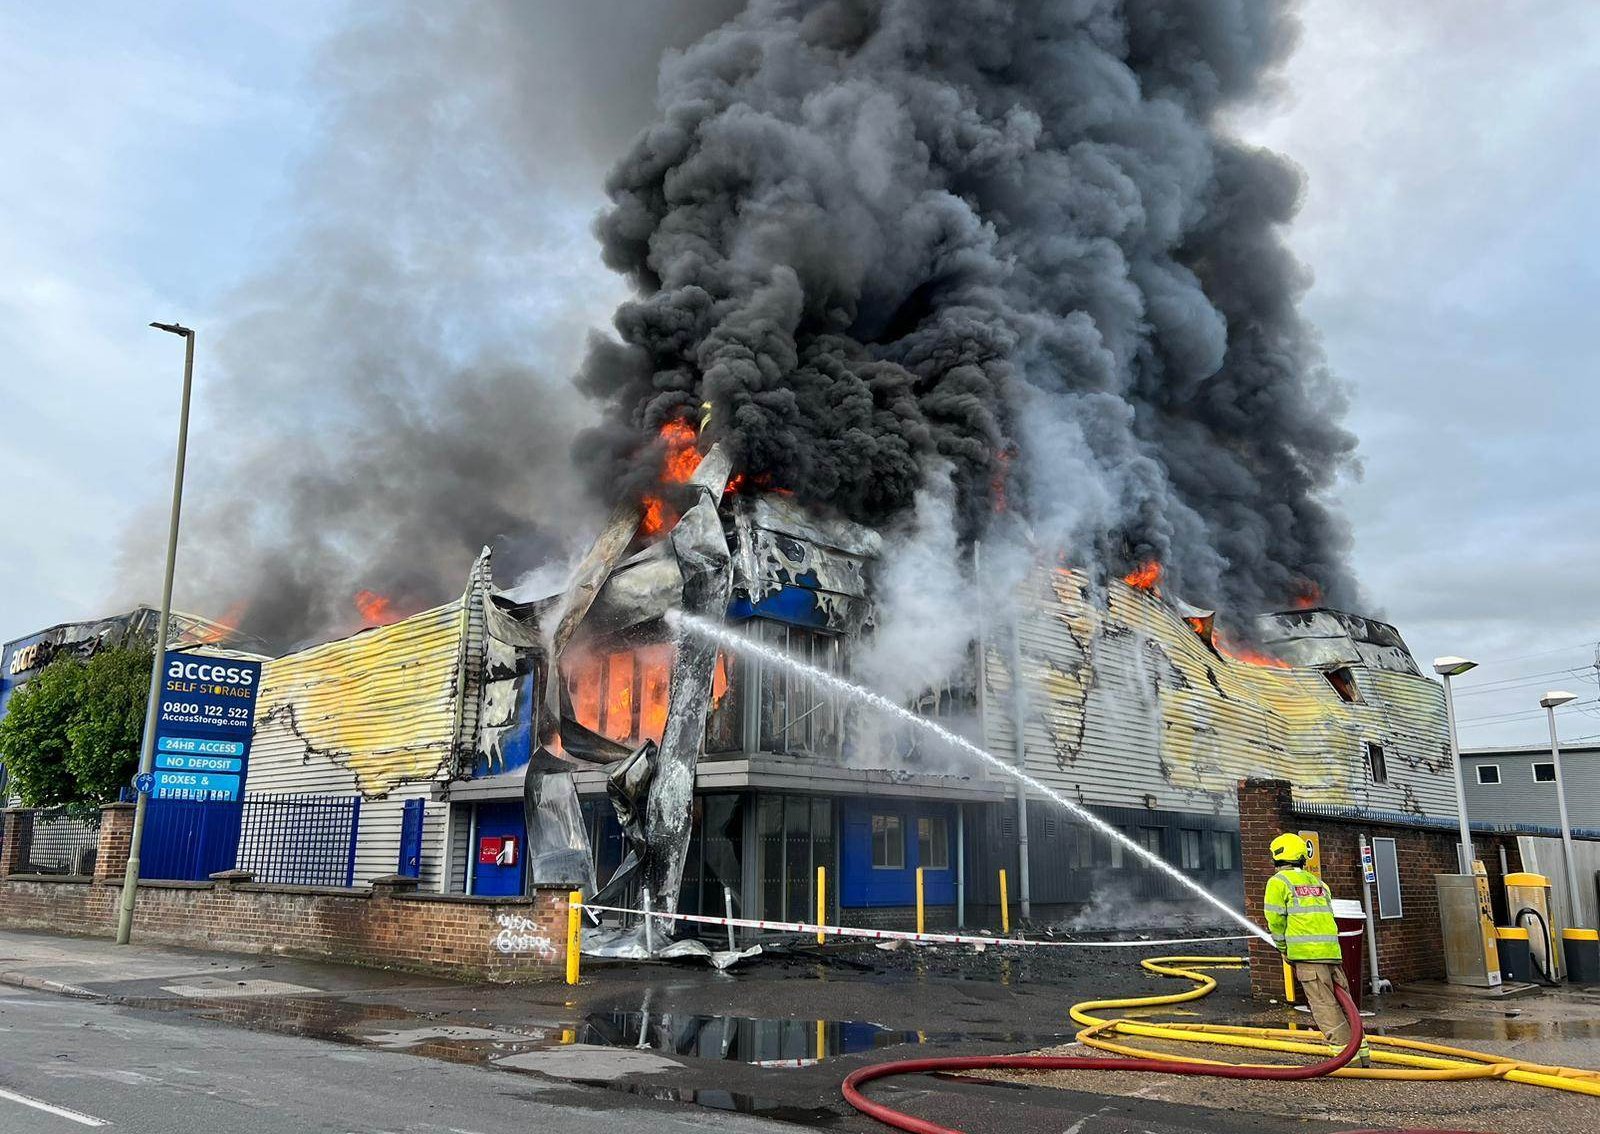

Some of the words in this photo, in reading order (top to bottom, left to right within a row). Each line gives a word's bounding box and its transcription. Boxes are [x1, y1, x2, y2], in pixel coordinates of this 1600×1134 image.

[168, 661, 254, 685] access
[166, 680, 197, 692] SELF
[199, 684, 251, 698] STORAGE
[163, 701, 199, 714] 0800
[204, 705, 223, 717] 122
[227, 707, 249, 719] 522
[162, 713, 247, 727] AccessStorage.com
[166, 740, 195, 751] 24HR
[198, 743, 236, 753] ACCESS
[166, 757, 184, 767] NO
[188, 758, 231, 769] DEPOSIT
[161, 775, 197, 785] BOXES
[201, 776, 209, 785] &
